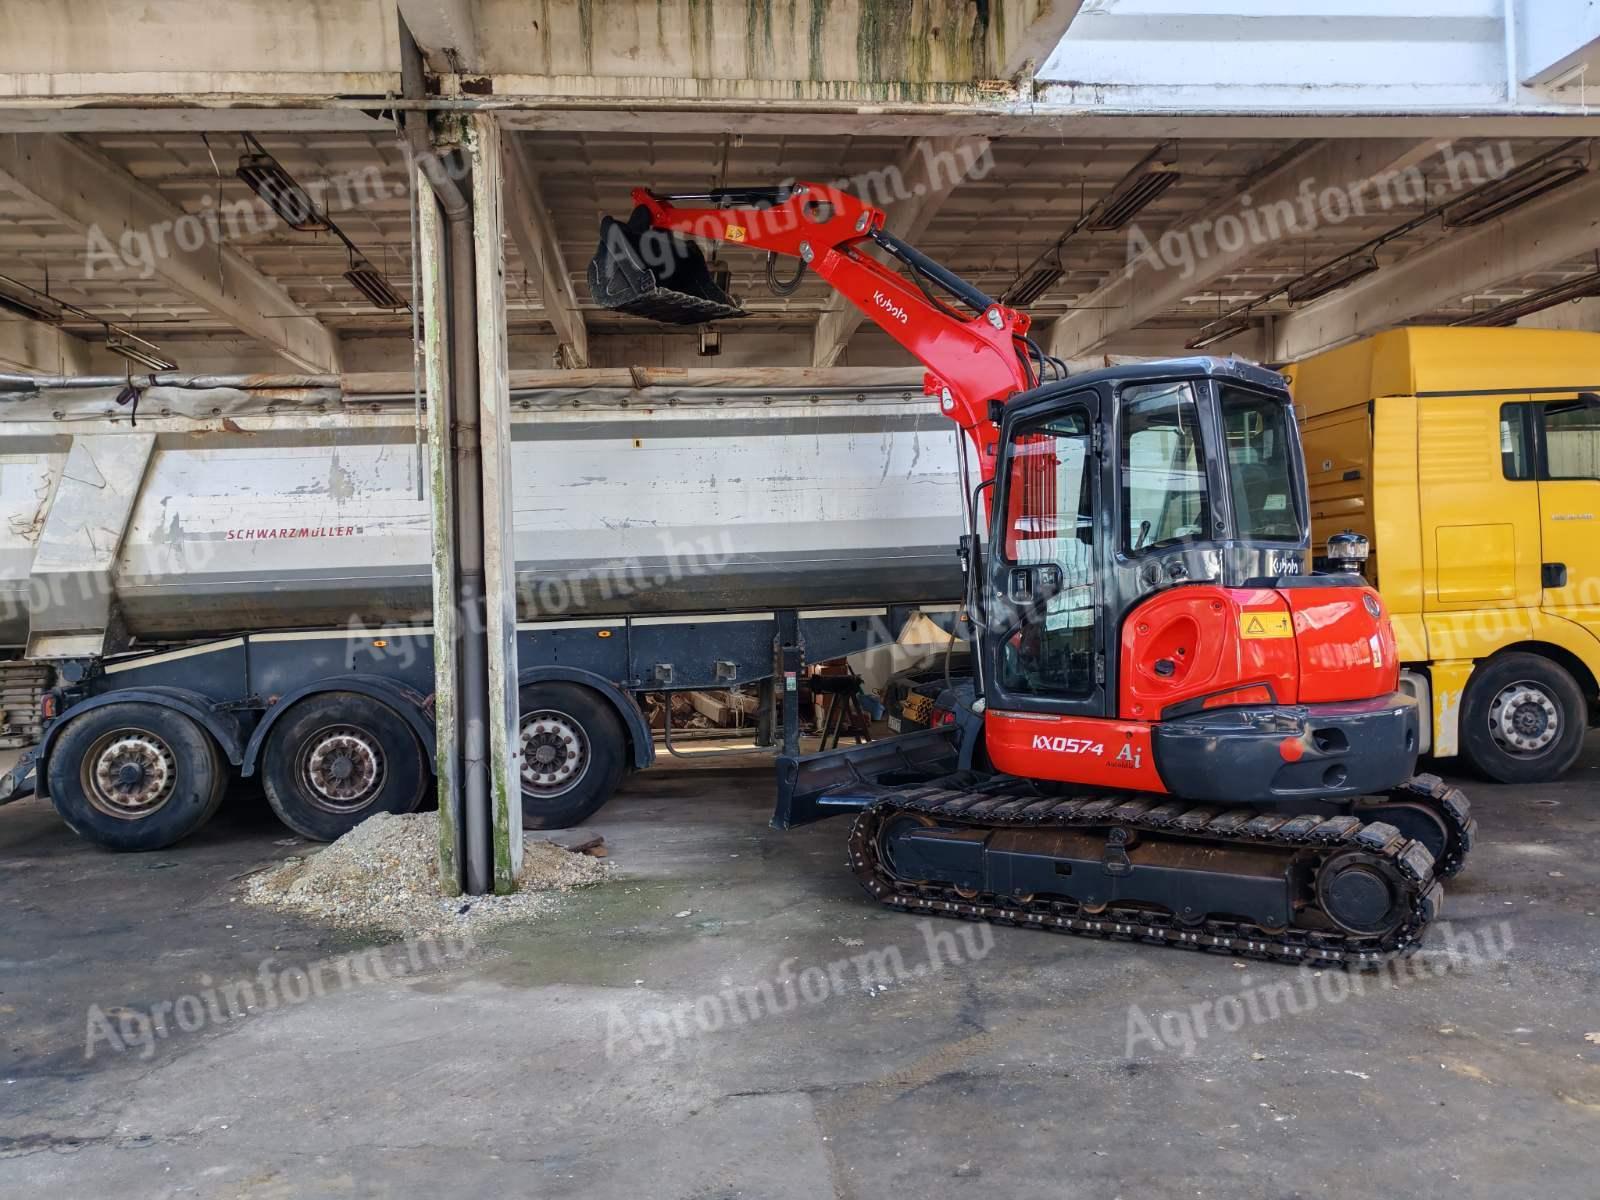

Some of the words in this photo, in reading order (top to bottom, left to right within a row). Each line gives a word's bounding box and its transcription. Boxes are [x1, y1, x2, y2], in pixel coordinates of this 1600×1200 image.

[873, 290, 908, 324] Kubota
[226, 526, 354, 540] SCHWARZMÜLLER
[1032, 735, 1104, 756] KX057-4
[1115, 743, 1142, 769] Ai
